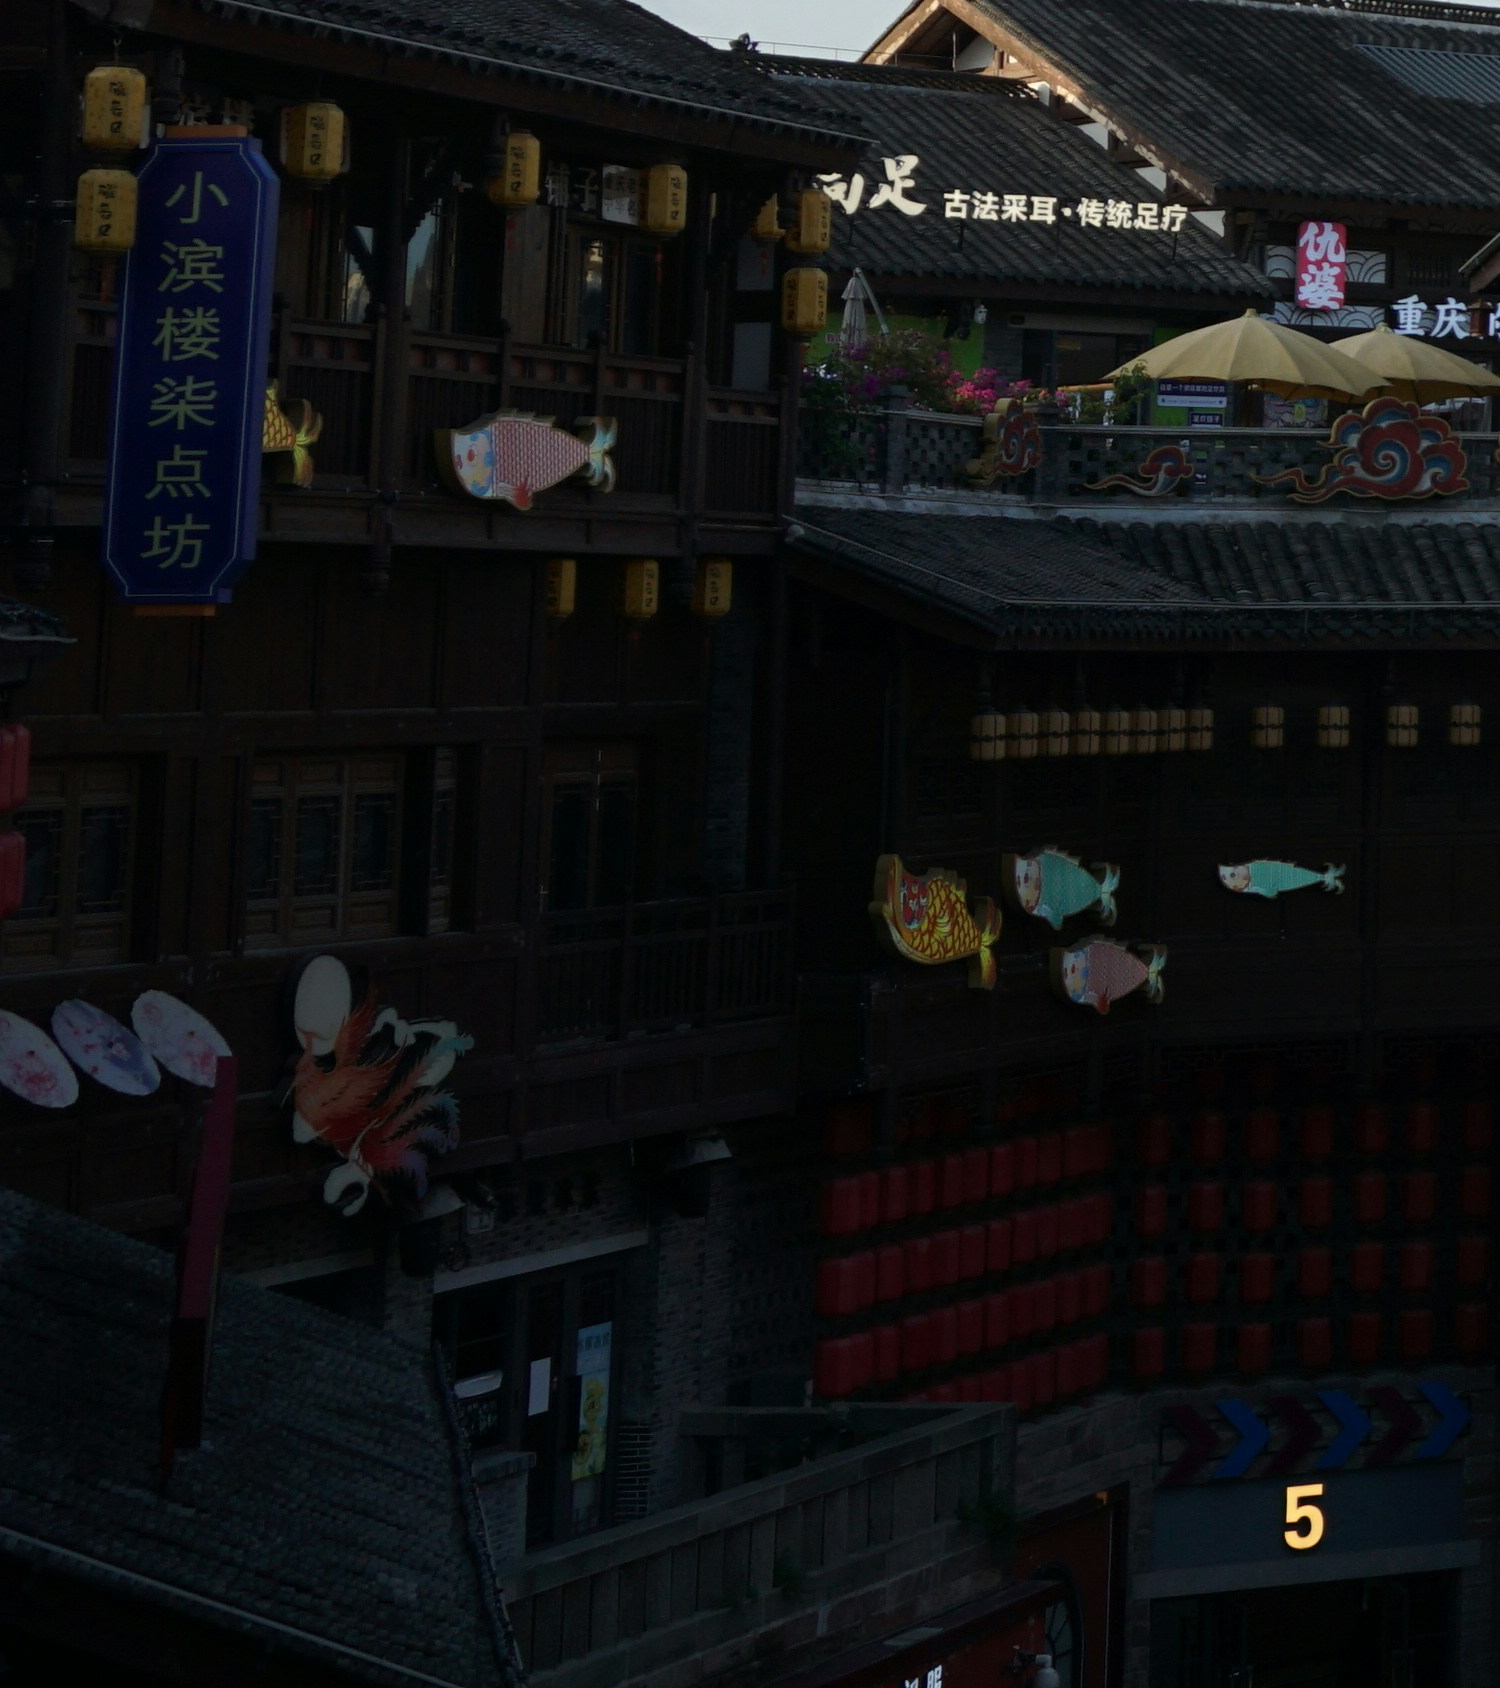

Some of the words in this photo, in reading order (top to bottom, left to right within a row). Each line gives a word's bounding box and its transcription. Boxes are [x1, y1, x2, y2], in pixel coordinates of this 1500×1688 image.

[1297, 221, 1346, 310] 仇婆
[139, 170, 230, 571] 小滨楼柒点坊
[1283, 1482, 1325, 1552] 5
